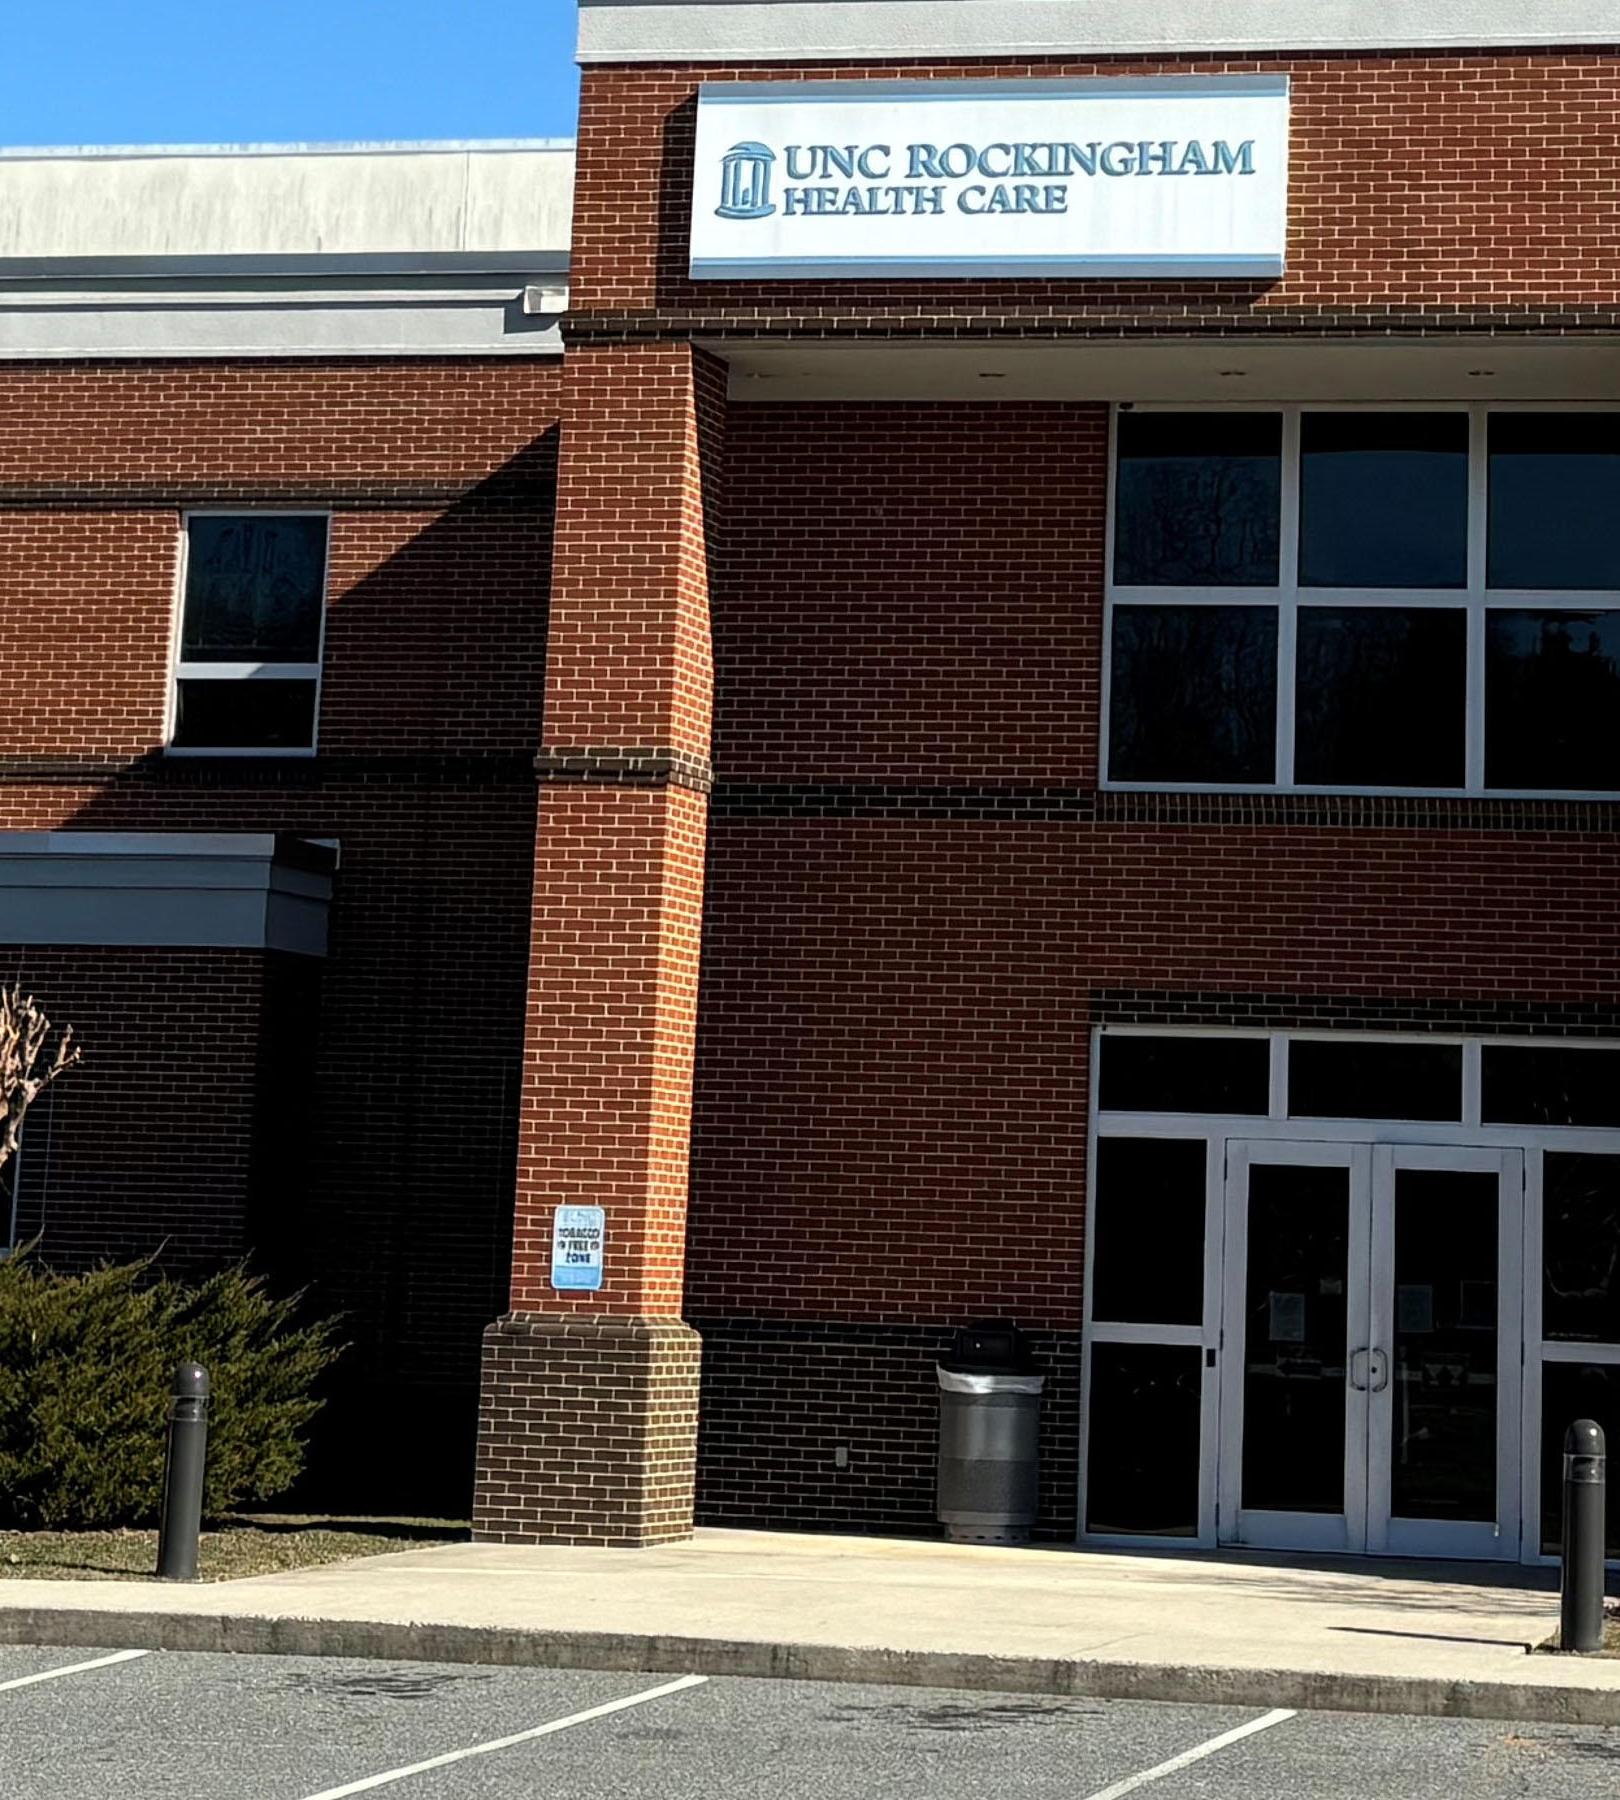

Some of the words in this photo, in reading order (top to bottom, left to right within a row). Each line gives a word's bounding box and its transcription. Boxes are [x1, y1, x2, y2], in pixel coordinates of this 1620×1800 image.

[783, 142, 891, 180] UNC
[905, 138, 1257, 178] ROCKINGHAM
[782, 185, 946, 217] HEALTH
[957, 183, 1070, 215] CARE
[558, 1227, 600, 1239] TOBACCO
[568, 1240, 589, 1251] FREE
[566, 1253, 590, 1264] ZONE
